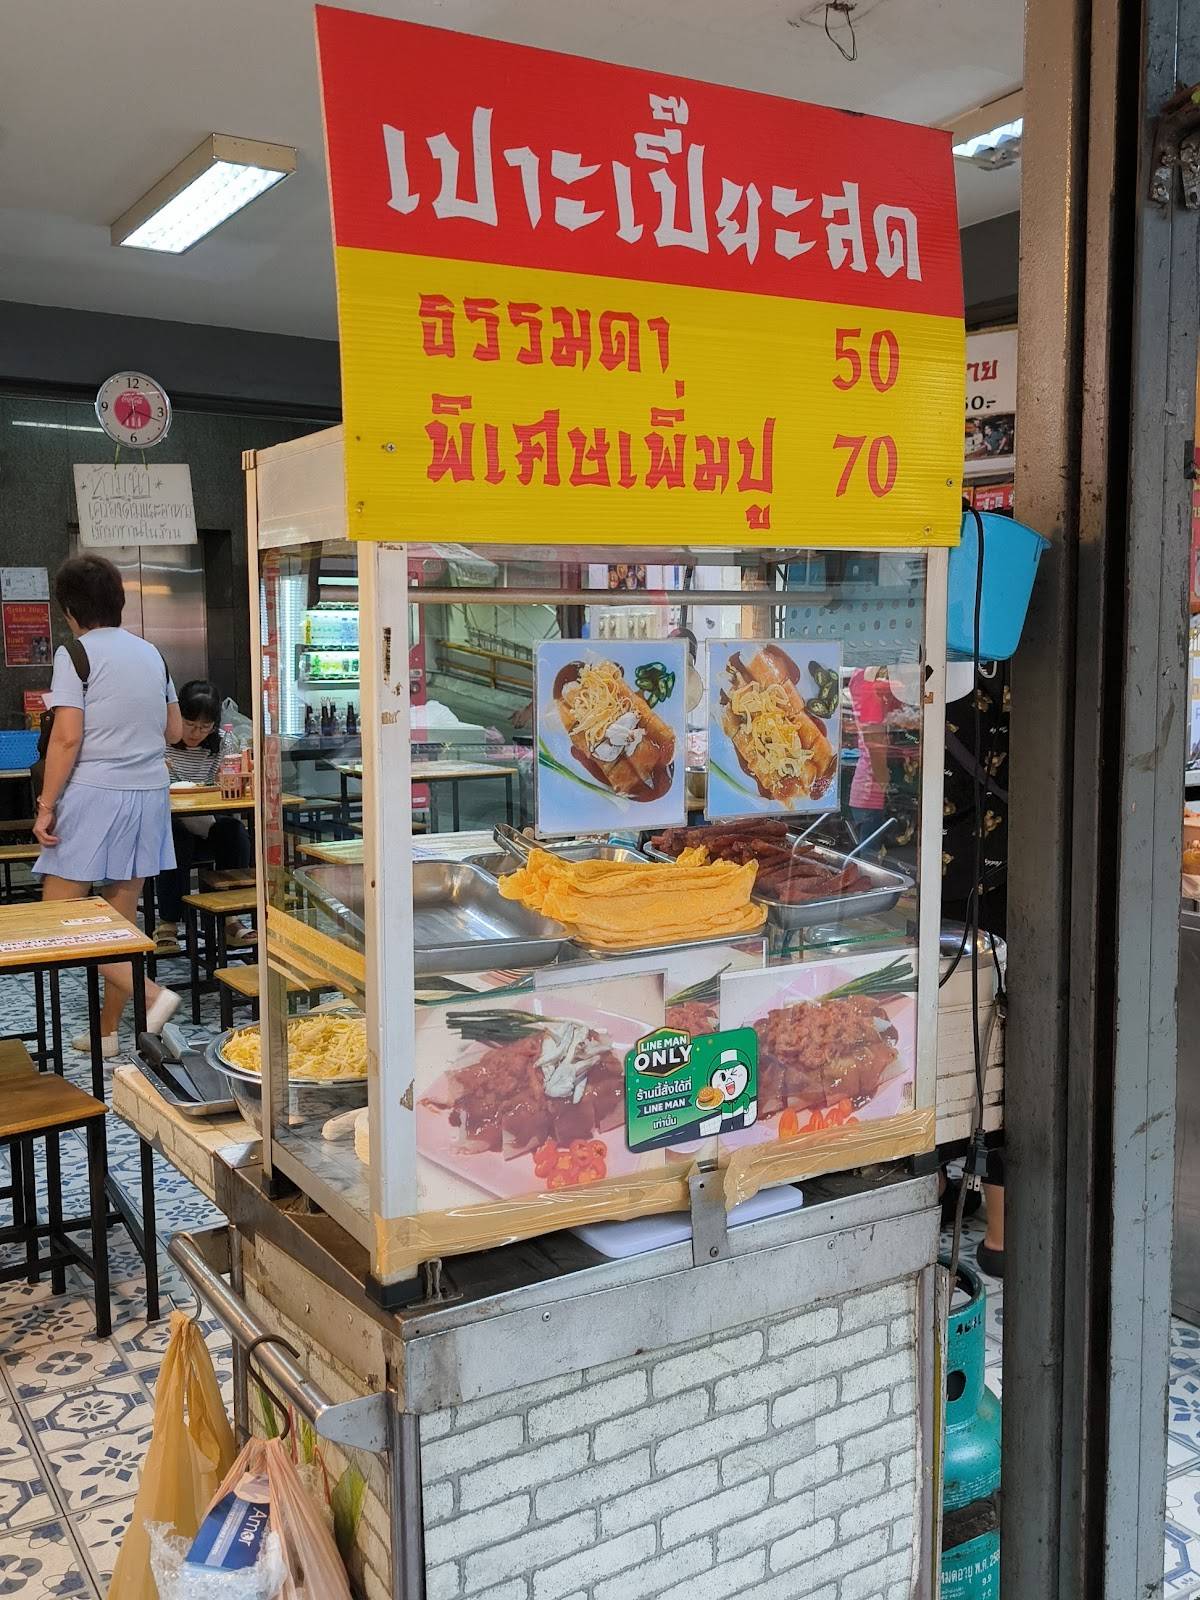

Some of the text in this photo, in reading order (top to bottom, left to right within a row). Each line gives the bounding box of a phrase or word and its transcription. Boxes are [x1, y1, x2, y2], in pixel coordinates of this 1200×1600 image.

[382, 93, 923, 282] เปาะเปี๊ยะสด
[418, 293, 901, 393] ธรรมดา 50
[127, 377, 140, 389] 12
[101, 401, 109, 412] 9
[157, 407, 164, 418] 3
[130, 432, 138, 443] 6
[425, 379, 899, 530] พิเศษเพิ่มปู 70
[641, 1035, 688, 1051] LINE MAN
[634, 1044, 693, 1071] ONLY
[636, 1076, 692, 1101] ร้านนี้สั่งได้ที่
[643, 1098, 686, 1115] LINE MAN
[653, 1114, 677, 1129] เท่านั้น
